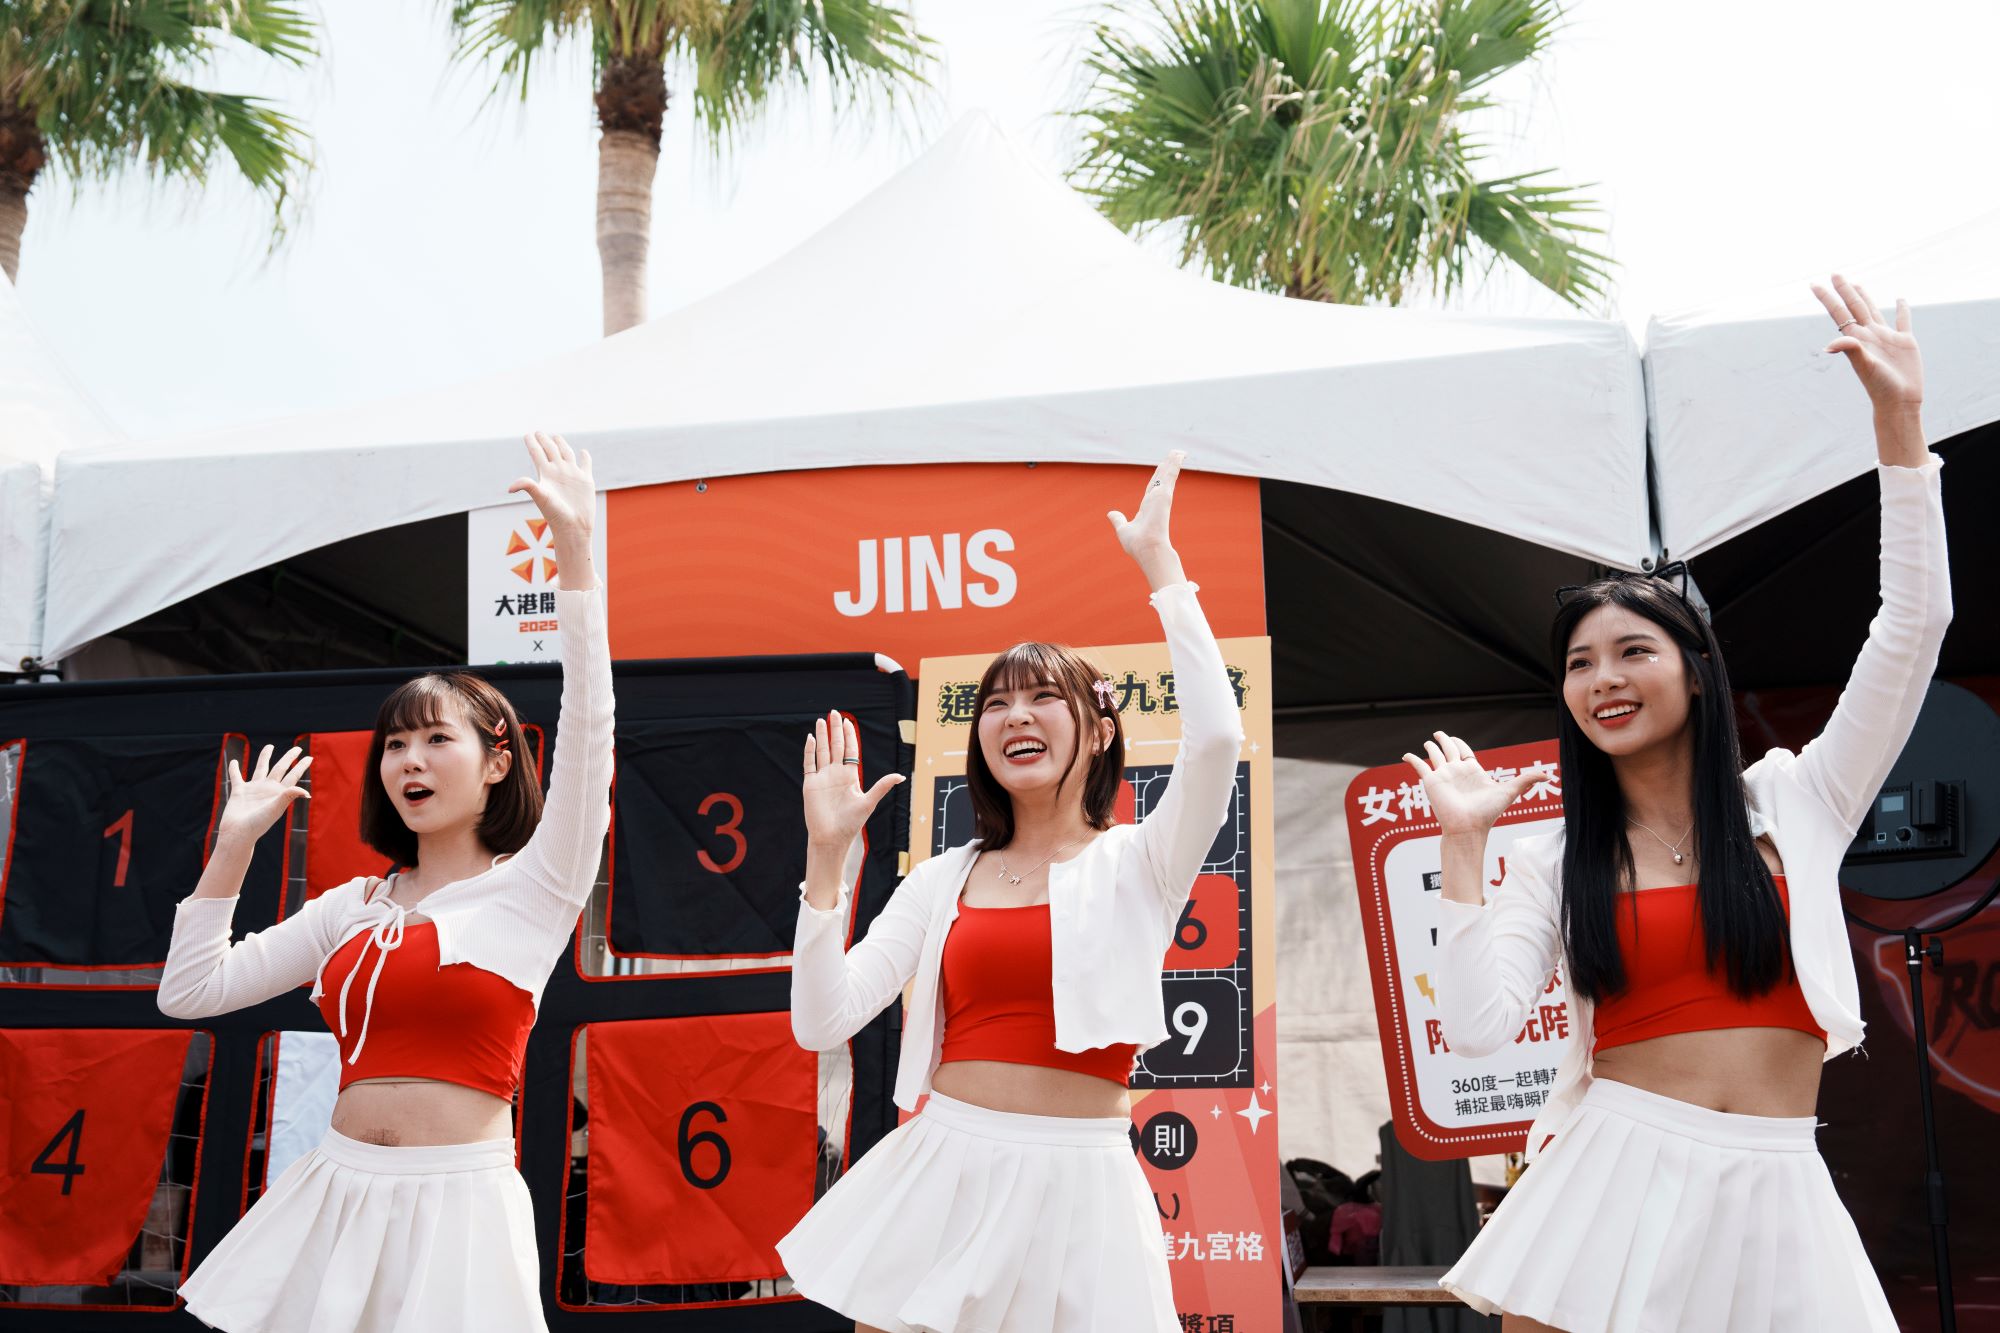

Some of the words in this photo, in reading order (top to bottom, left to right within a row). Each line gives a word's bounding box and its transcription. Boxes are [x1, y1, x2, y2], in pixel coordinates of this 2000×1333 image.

[833, 528, 1018, 617] JINS
[519, 620, 558, 632] 2025
[102, 808, 133, 887] 1
[696, 792, 747, 874] 3
[1174, 899, 1208, 950] 6
[1172, 1001, 1208, 1055] 9
[31, 1109, 86, 1195] 4
[677, 1101, 731, 1189] 6
